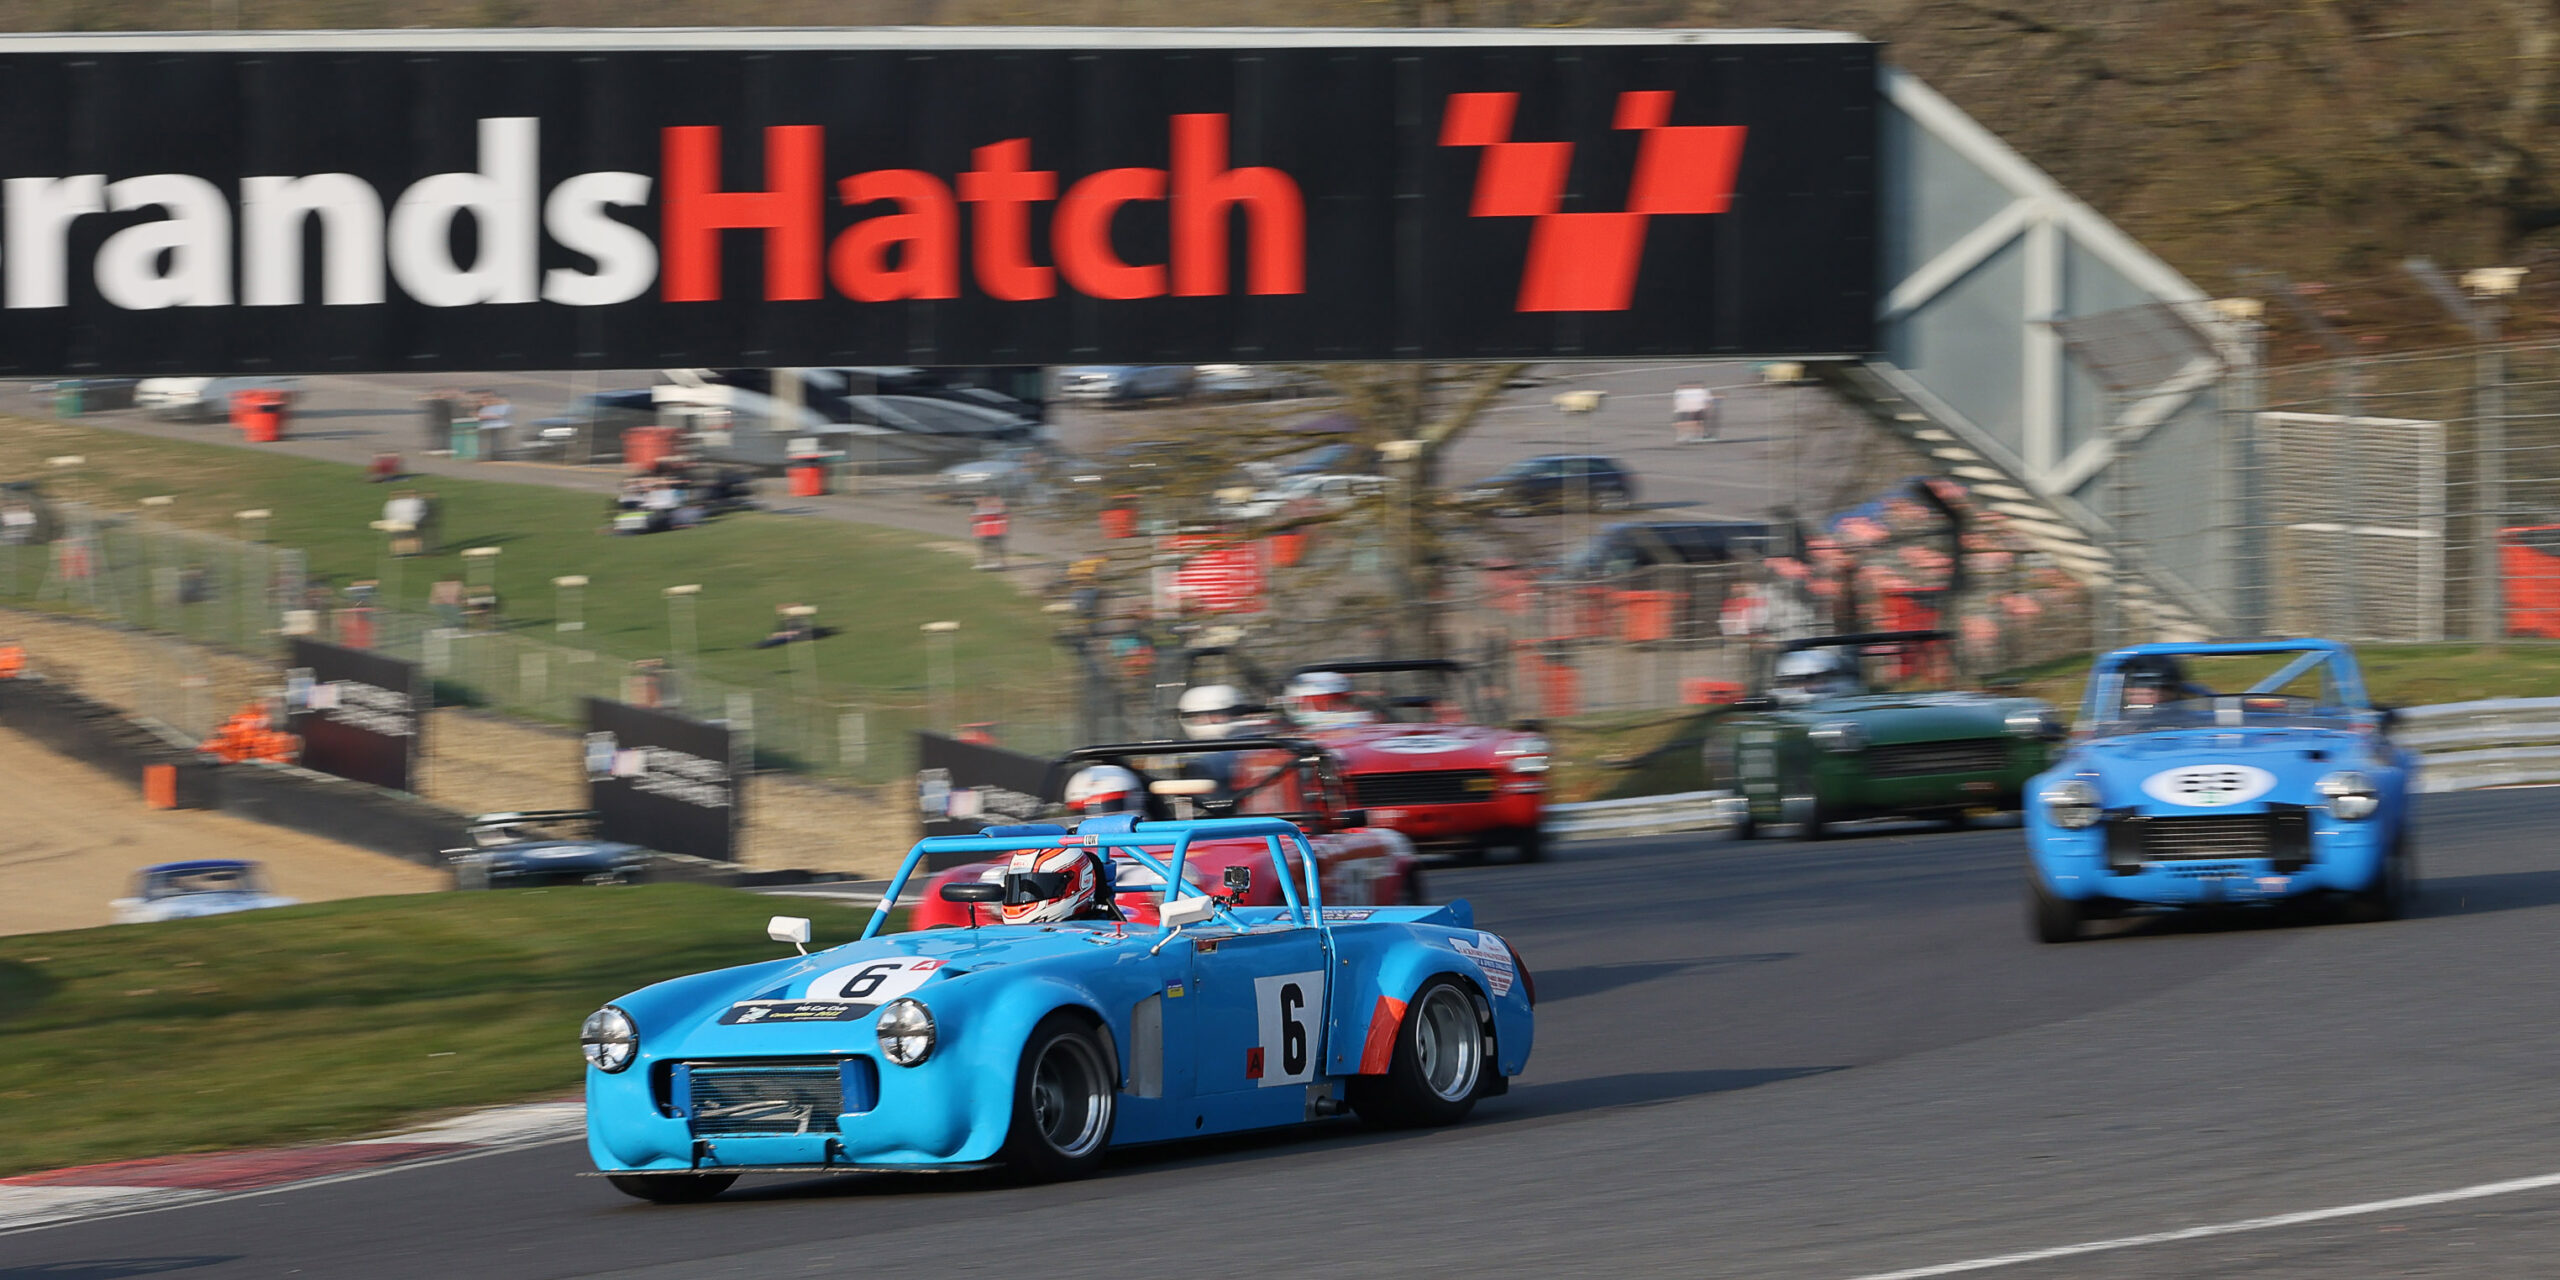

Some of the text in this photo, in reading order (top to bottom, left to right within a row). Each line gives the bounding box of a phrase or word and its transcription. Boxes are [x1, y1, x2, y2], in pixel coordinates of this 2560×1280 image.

[0, 113, 1306, 310] randsHatch
[839, 963, 902, 998] 6
[912, 960, 937, 970] A
[1280, 983, 1306, 1075] 6
[1250, 1052, 1262, 1068] A
